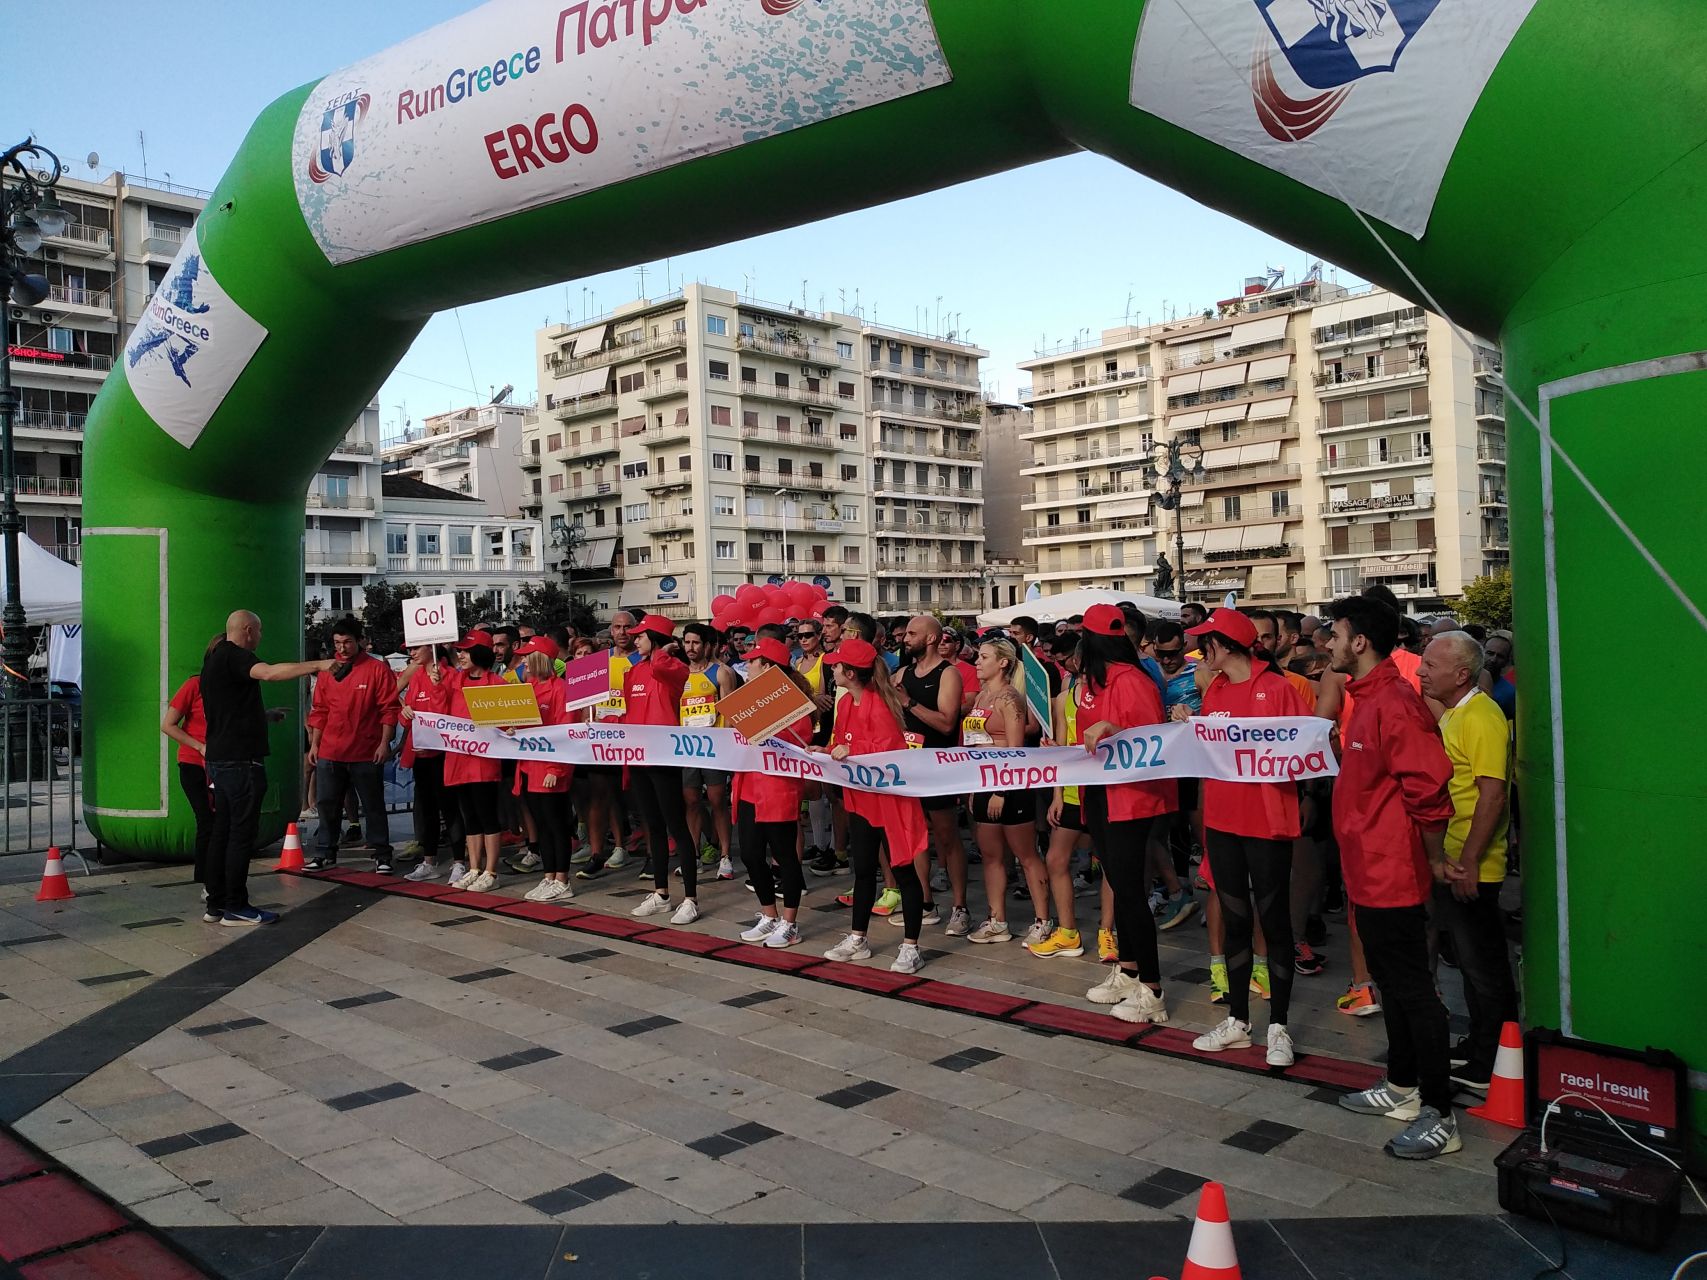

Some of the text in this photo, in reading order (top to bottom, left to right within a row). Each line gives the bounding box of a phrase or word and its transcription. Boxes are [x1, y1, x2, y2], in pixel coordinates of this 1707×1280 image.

[397, 46, 541, 125] RunGreece
[325, 87, 362, 110] ΣΕΓΑΣ
[484, 103, 599, 180] ERGO
[1332, 498, 1368, 508] MASSAGE
[1385, 494, 1413, 503] RITUAL
[1185, 579, 1204, 587] Gold
[1208, 576, 1239, 585] Traders
[415, 605, 445, 626] Go!
[472, 699, 496, 709] Λίγο
[498, 697, 533, 708] έμεινε
[685, 704, 711, 716] 1473
[686, 697, 706, 706] ERGO
[731, 705, 759, 724] Πάμε
[756, 683, 792, 708] δυνατά
[418, 716, 475, 733] RunGreece
[568, 728, 626, 740] RunGreece
[965, 718, 981, 730] 1106
[1194, 722, 1299, 743] RunGreece
[440, 733, 491, 755] Πάτρα
[592, 743, 646, 765] Πάτρα
[670, 733, 716, 758] 2022
[1097, 735, 1167, 771] 2022
[762, 751, 823, 778] Πάτρα
[935, 750, 1027, 765] RunGreece
[1234, 748, 1329, 781] Πάτρα
[841, 763, 907, 788] 2022
[979, 762, 1058, 789] Πάτρα
